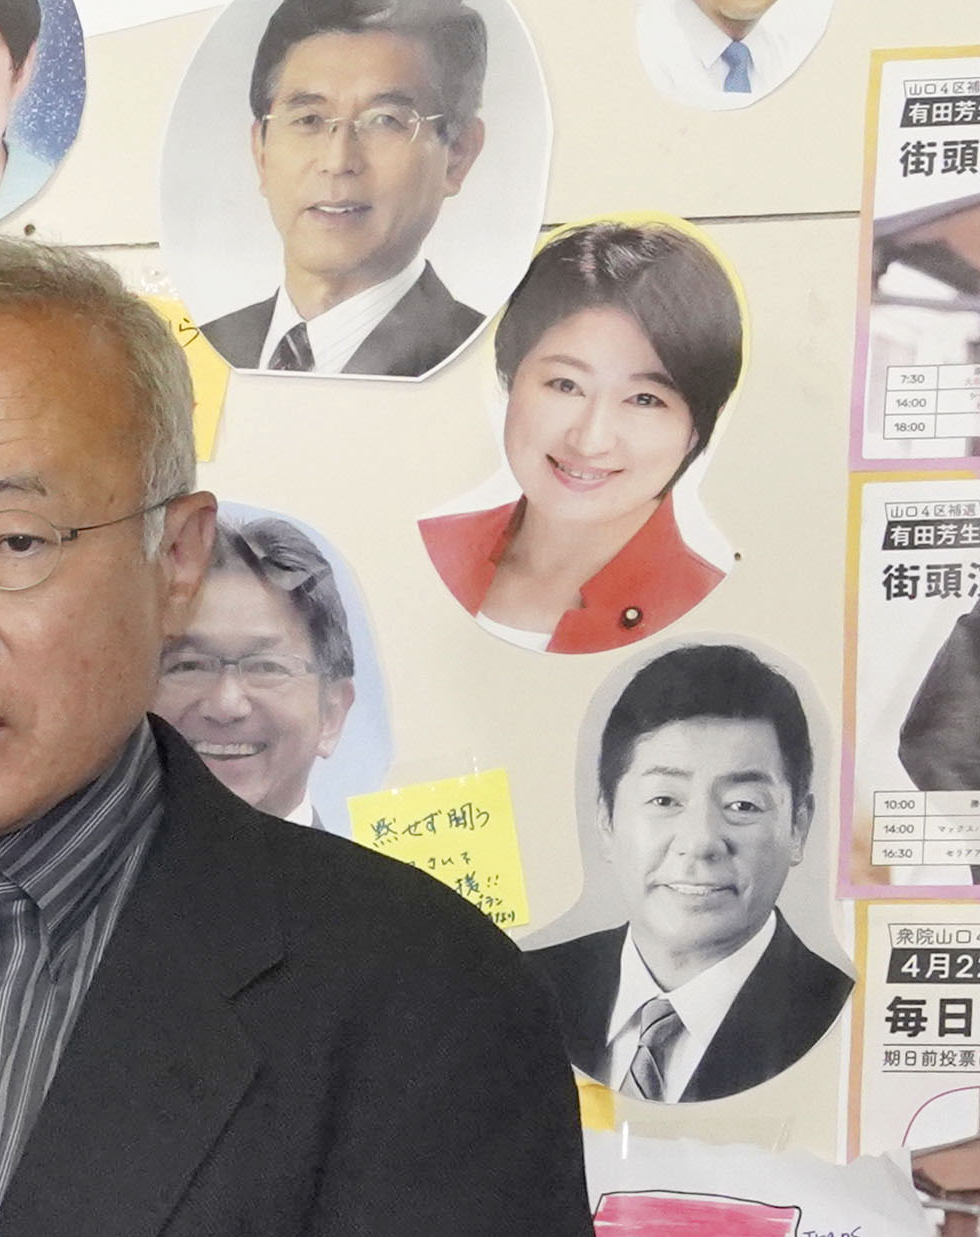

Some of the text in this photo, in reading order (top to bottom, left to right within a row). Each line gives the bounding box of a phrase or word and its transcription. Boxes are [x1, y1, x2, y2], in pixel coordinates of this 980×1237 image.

[908, 101, 980, 123] 有田芳
[900, 140, 979, 177] 街頭
[900, 374, 925, 384] 7:30
[895, 398, 927, 408] 14:00
[894, 422, 925, 432] 18:00
[889, 523, 980, 546] 有田芳生
[884, 800, 915, 810] 10:00
[883, 824, 914, 834] 14:00
[882, 848, 913, 858] 16:30
[896, 928, 980, 945] 衆院山口
[901, 953, 980, 978] 4月2
[885, 996, 973, 1038] 毎日
[883, 1049, 980, 1067] 期日前投票
